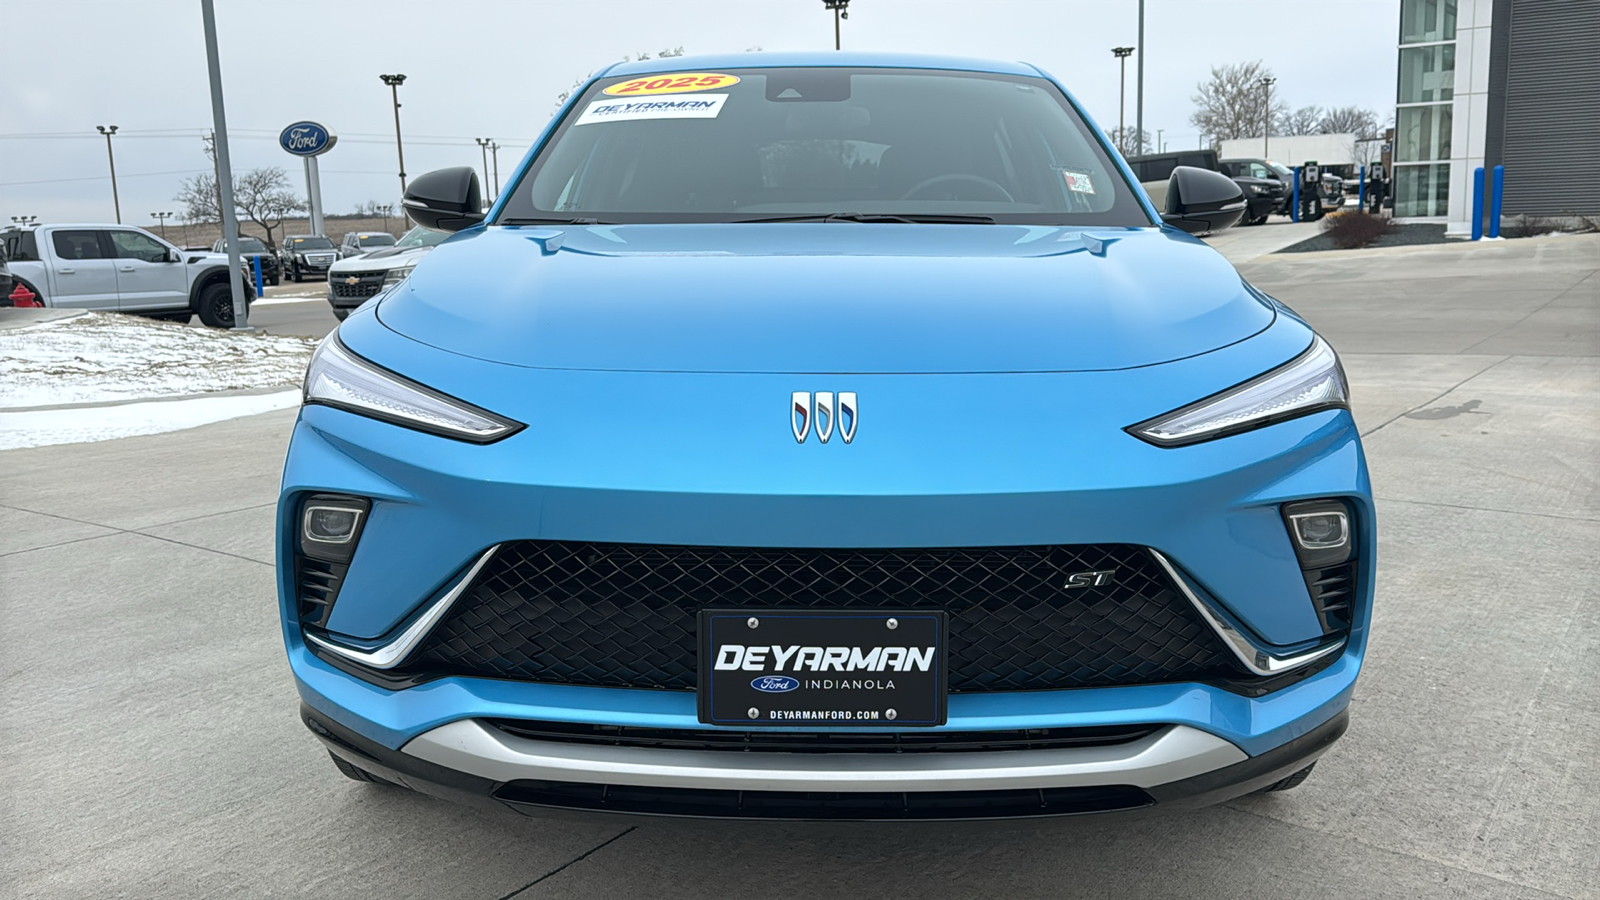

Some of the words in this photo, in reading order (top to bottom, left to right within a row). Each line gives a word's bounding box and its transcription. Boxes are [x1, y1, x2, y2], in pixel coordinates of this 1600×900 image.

[616, 75, 726, 94] 2025
[592, 101, 717, 114] DEYARMAN
[599, 108, 647, 116] CERTIFIED
[288, 128, 319, 149] Ford
[1064, 570, 1116, 589] ST
[714, 644, 936, 672] DEYARMAN
[760, 677, 789, 690] Ford
[805, 679, 896, 690] INDIANOLA
[770, 710, 879, 720] DEYARMANFORD.COM
